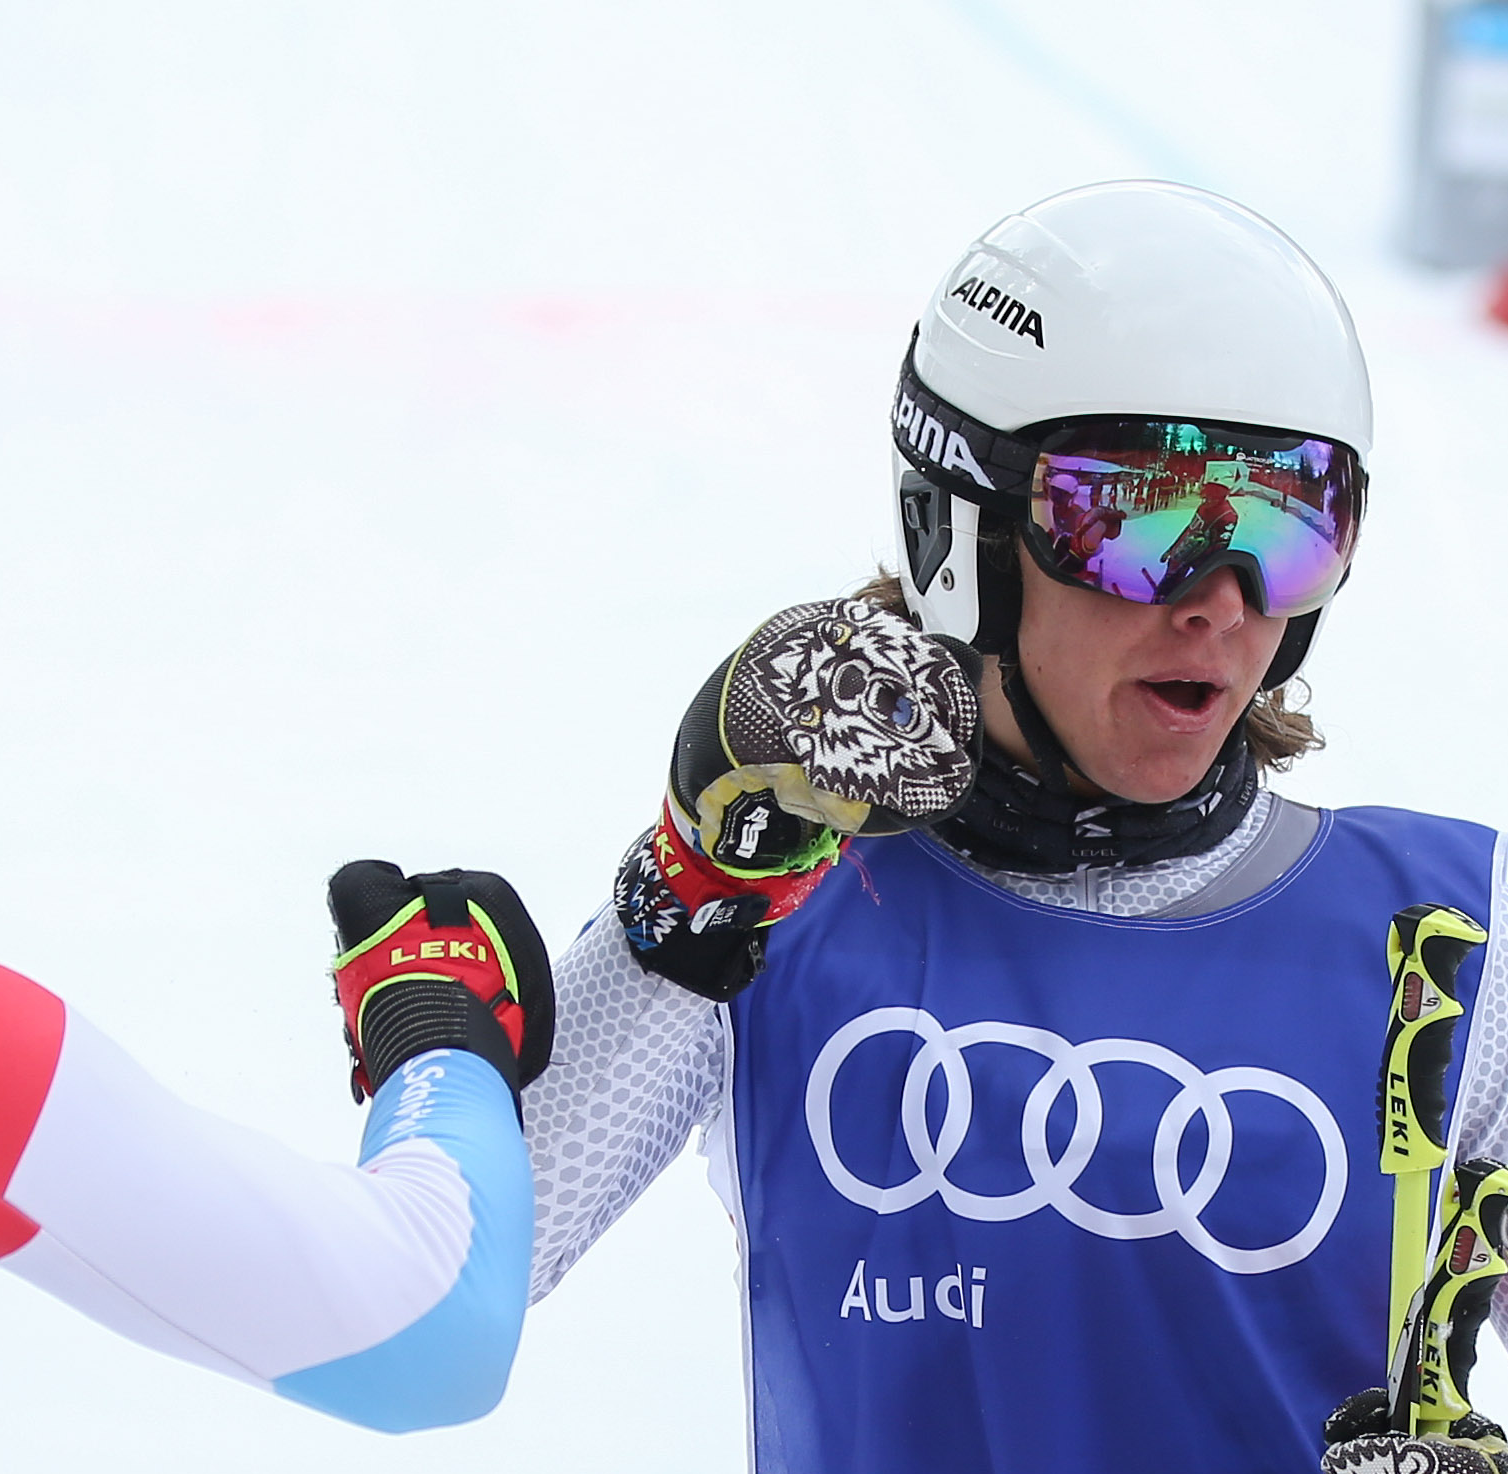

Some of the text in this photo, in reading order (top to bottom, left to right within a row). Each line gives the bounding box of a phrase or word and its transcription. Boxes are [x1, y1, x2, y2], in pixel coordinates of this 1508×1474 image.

[951, 276, 1045, 350] ALPINA
[893, 391, 996, 490] PINA
[656, 831, 685, 878] KI
[1071, 848, 1119, 858] LEVEL
[390, 940, 488, 966] LEKI
[1389, 1071, 1410, 1157] LEKI
[840, 1259, 987, 1329] Audi
[1421, 1320, 1441, 1407] LEKI
